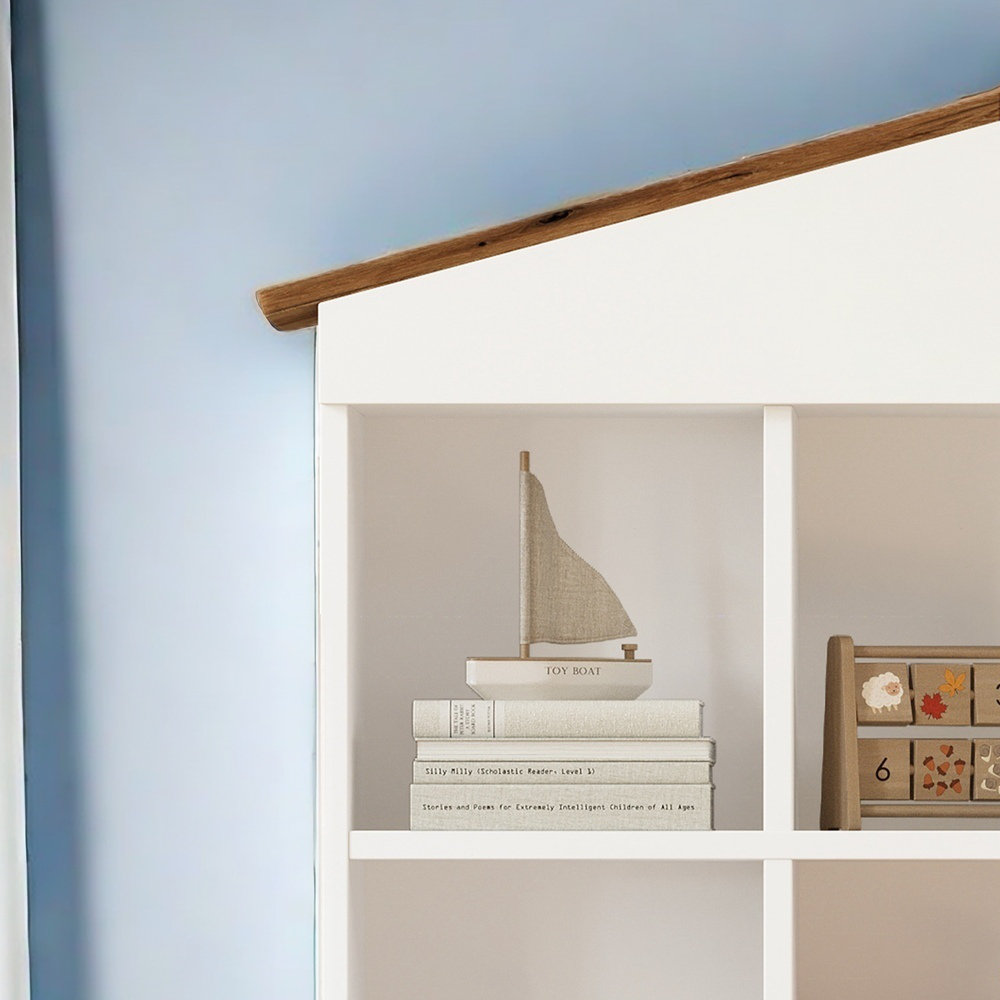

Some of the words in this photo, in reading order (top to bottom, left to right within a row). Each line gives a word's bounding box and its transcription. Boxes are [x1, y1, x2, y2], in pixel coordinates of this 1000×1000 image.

[546, 666, 568, 676] TOY
[573, 666, 601, 676] BOAT
[425, 767, 447, 776] Silly
[451, 767, 473, 776] Milly
[477, 767, 524, 776] (Scholastic
[561, 767, 583, 775] Level
[875, 757, 891, 782] 6
[422, 803, 453, 811] Stories
[456, 803, 470, 811] and
[473, 803, 495, 811] Poems
[499, 803, 512, 811] for
[515, 803, 555, 812] Extremely
[559, 803, 606, 812] Intelligent
[609, 803, 645, 811] Children
[648, 803, 657, 811] of
[660, 803, 673, 811] All
[677, 803, 695, 812] Ages
